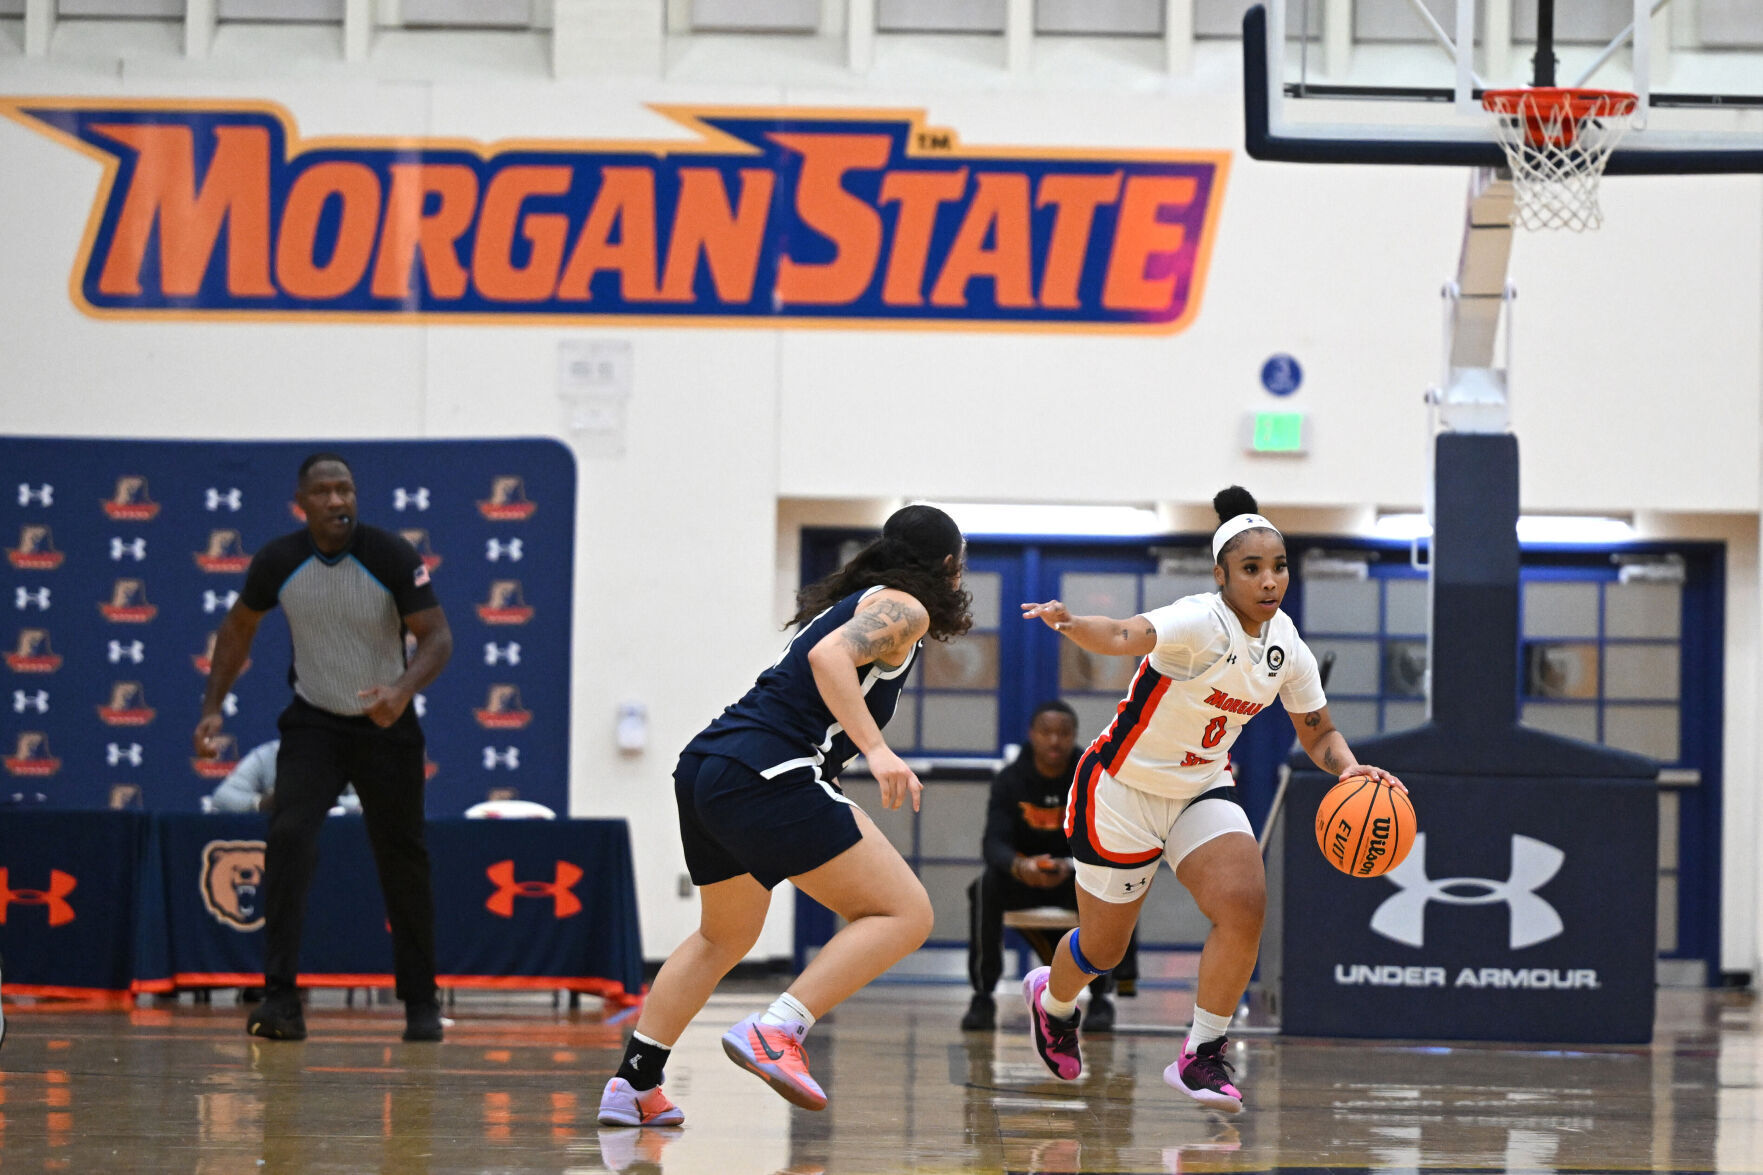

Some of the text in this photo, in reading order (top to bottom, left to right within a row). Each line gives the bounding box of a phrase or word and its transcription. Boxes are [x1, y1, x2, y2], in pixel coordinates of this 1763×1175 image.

[88, 123, 1199, 310] MORGAN STATE
[1201, 715, 1227, 749] 0
[1357, 817, 1391, 875] Wilson
[1335, 964, 1447, 987] UNDER
